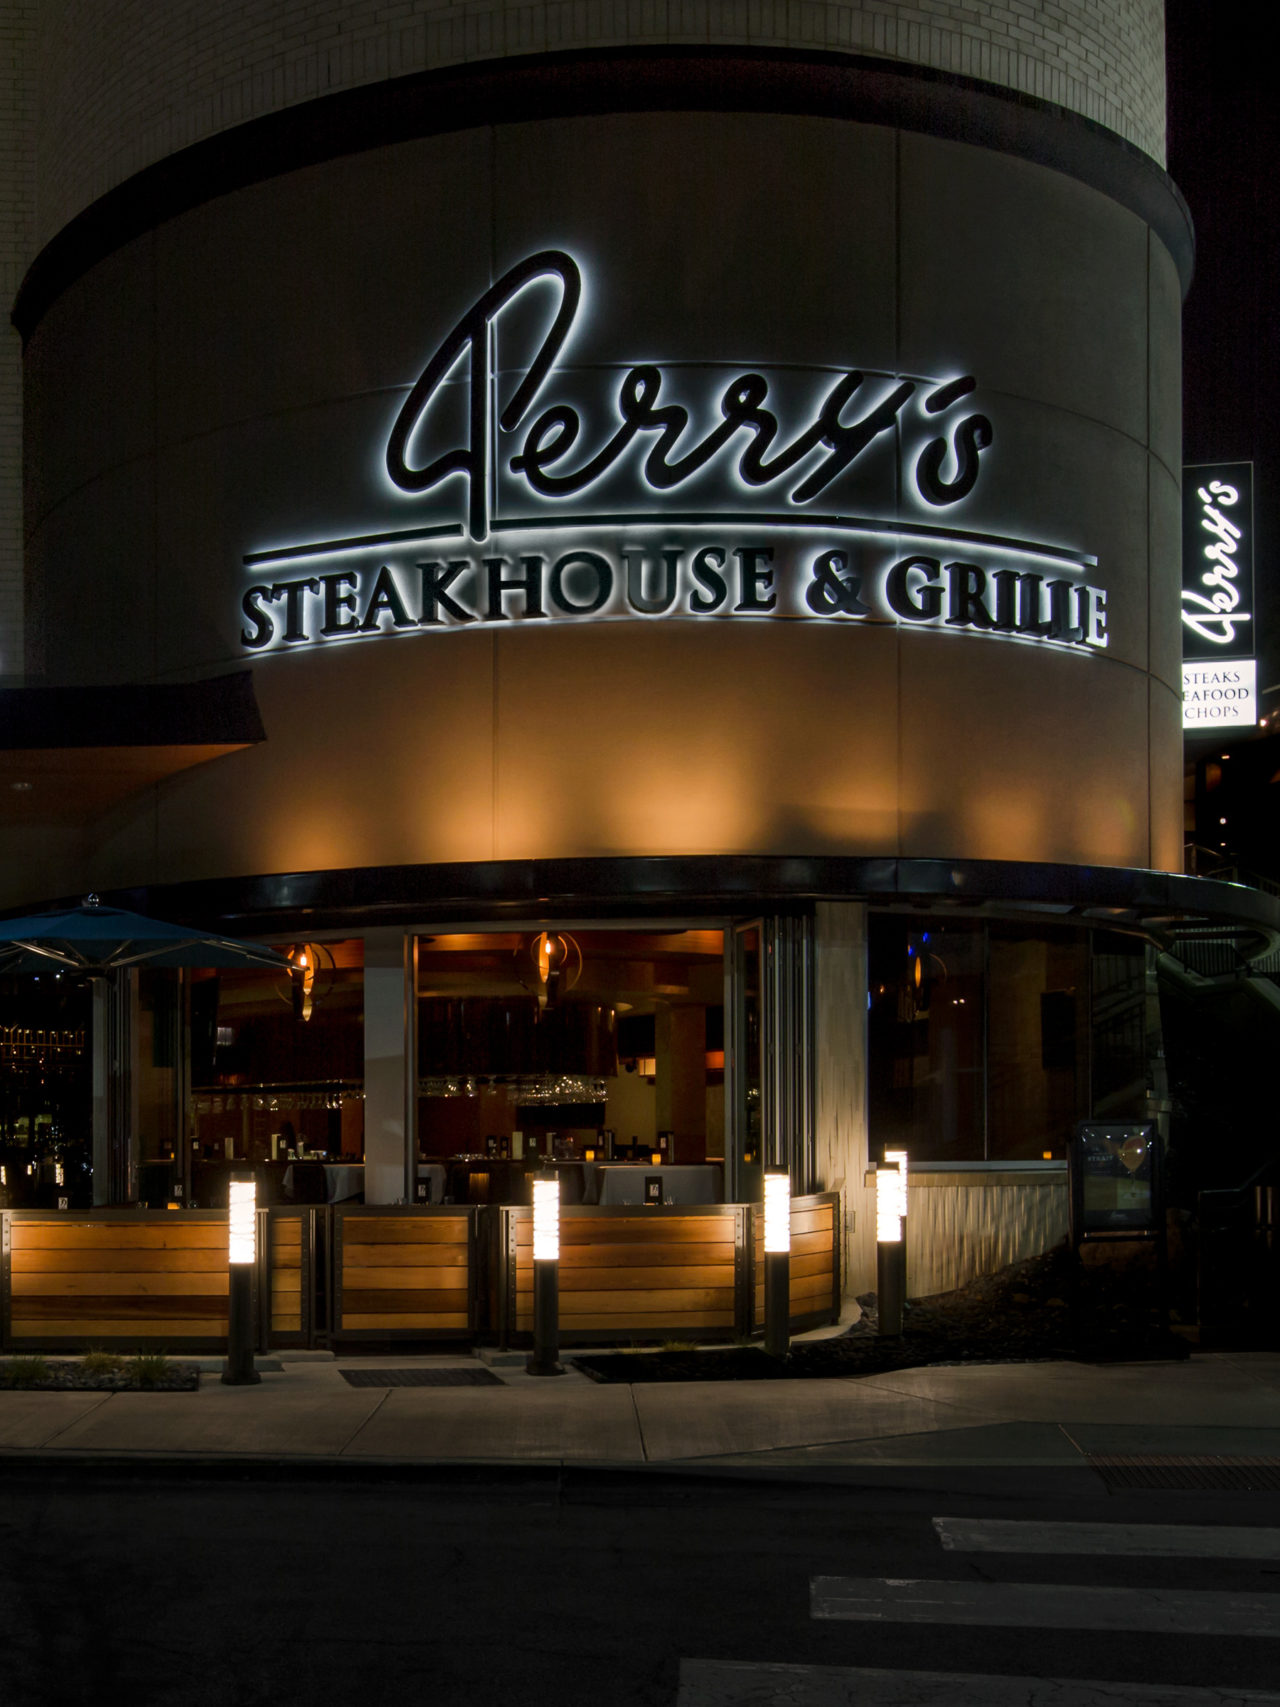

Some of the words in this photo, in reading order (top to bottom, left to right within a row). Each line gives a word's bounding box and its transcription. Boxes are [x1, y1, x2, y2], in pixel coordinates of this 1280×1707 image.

[386, 250, 993, 541] Perry's
[1181, 480, 1251, 644] Perry's
[240, 547, 776, 651] STEAKHOUSE
[805, 548, 871, 616] &
[885, 555, 1109, 649] GRILLE
[1182, 687, 1249, 702] EAFOOD
[1183, 671, 1241, 685] STEAKS
[1184, 705, 1240, 720] CHOPS
